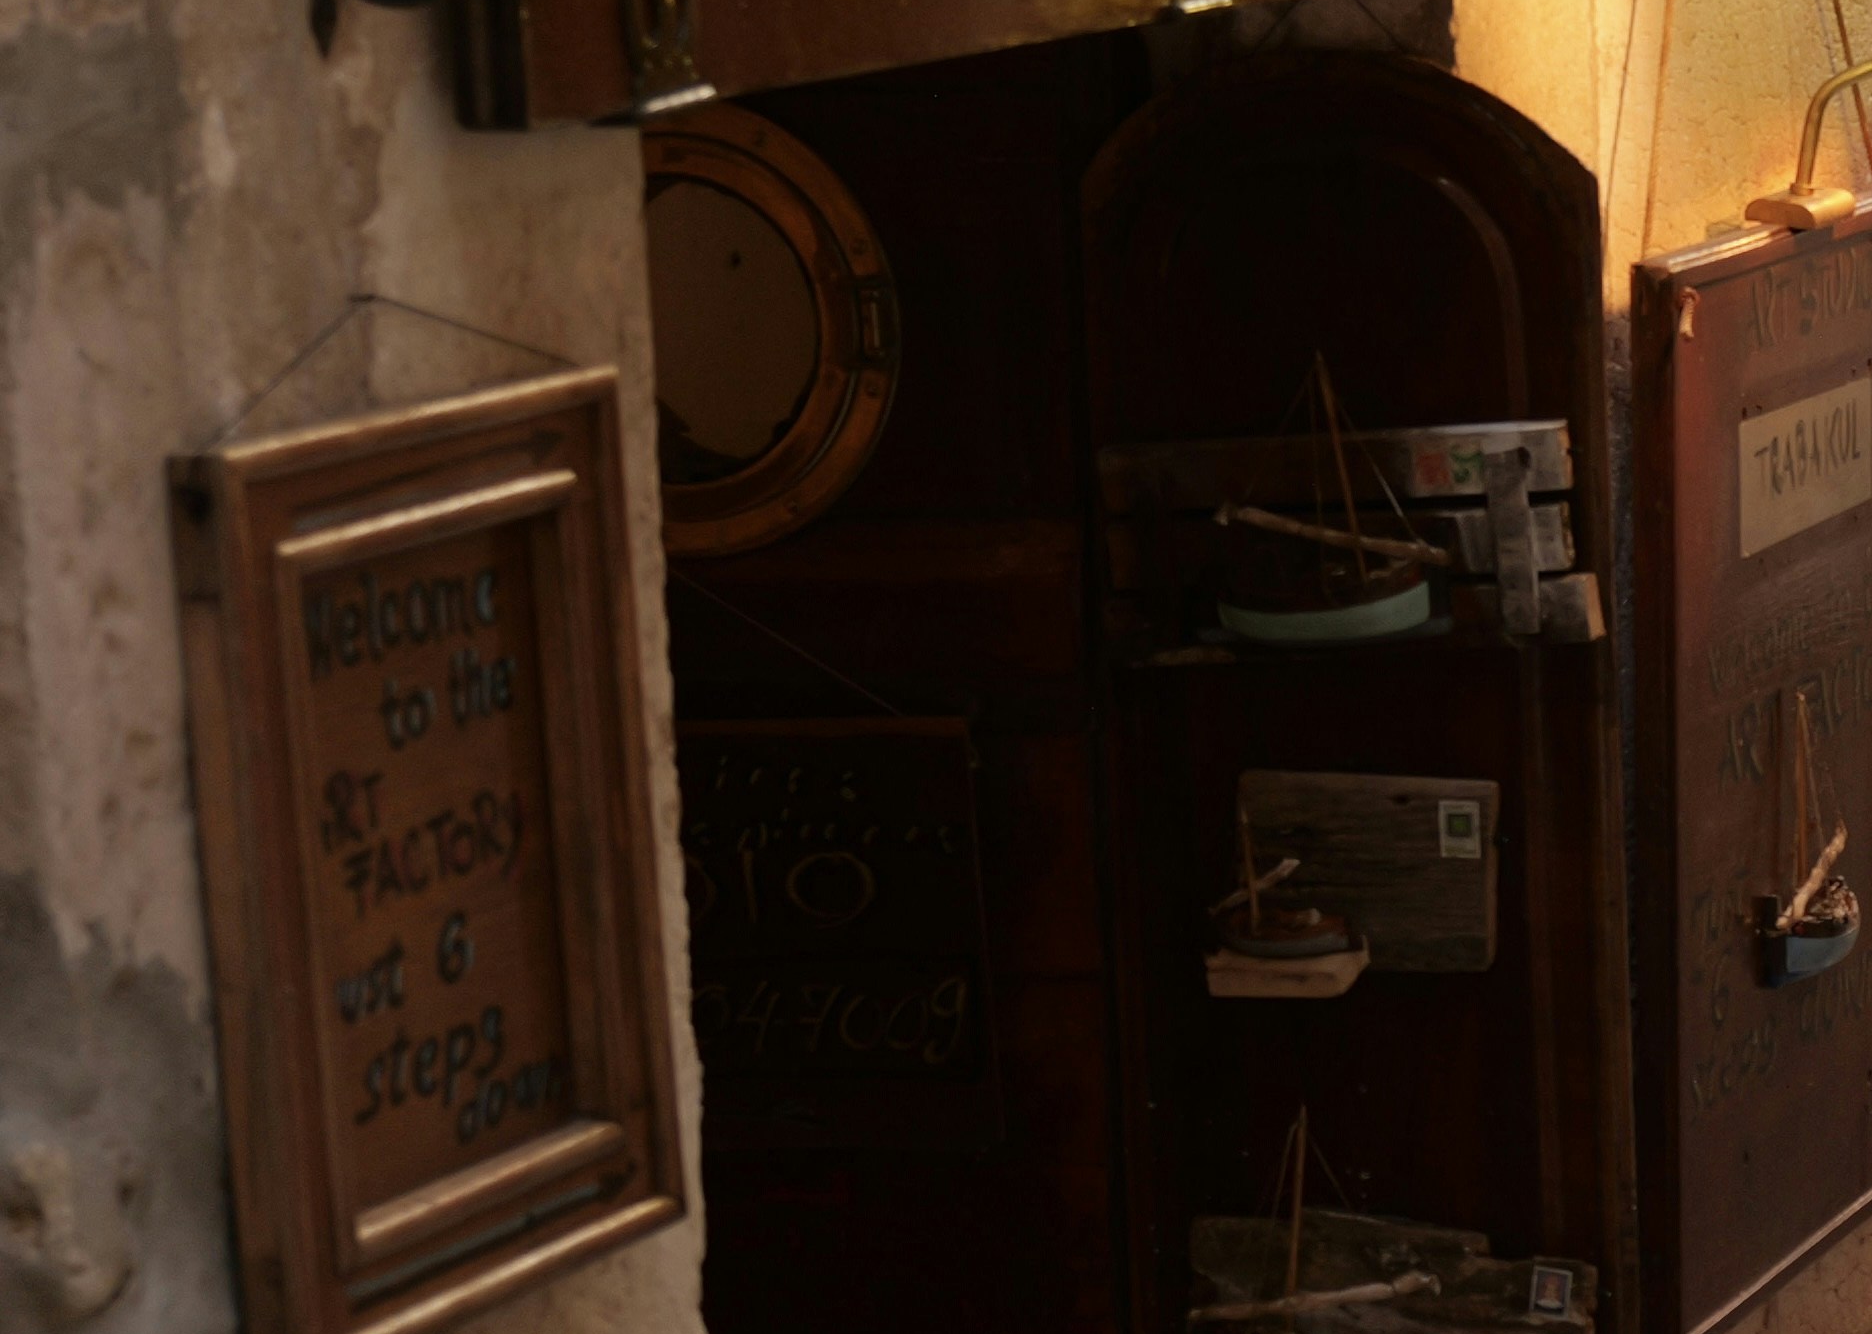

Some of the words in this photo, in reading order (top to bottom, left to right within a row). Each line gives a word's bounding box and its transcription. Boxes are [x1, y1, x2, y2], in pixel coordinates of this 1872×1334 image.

[1753, 397, 1862, 501] TRABAKUL
[302, 565, 499, 683] Welcome
[379, 677, 438, 751] to
[446, 646, 519, 727] the
[352, 1003, 507, 1127] steps
